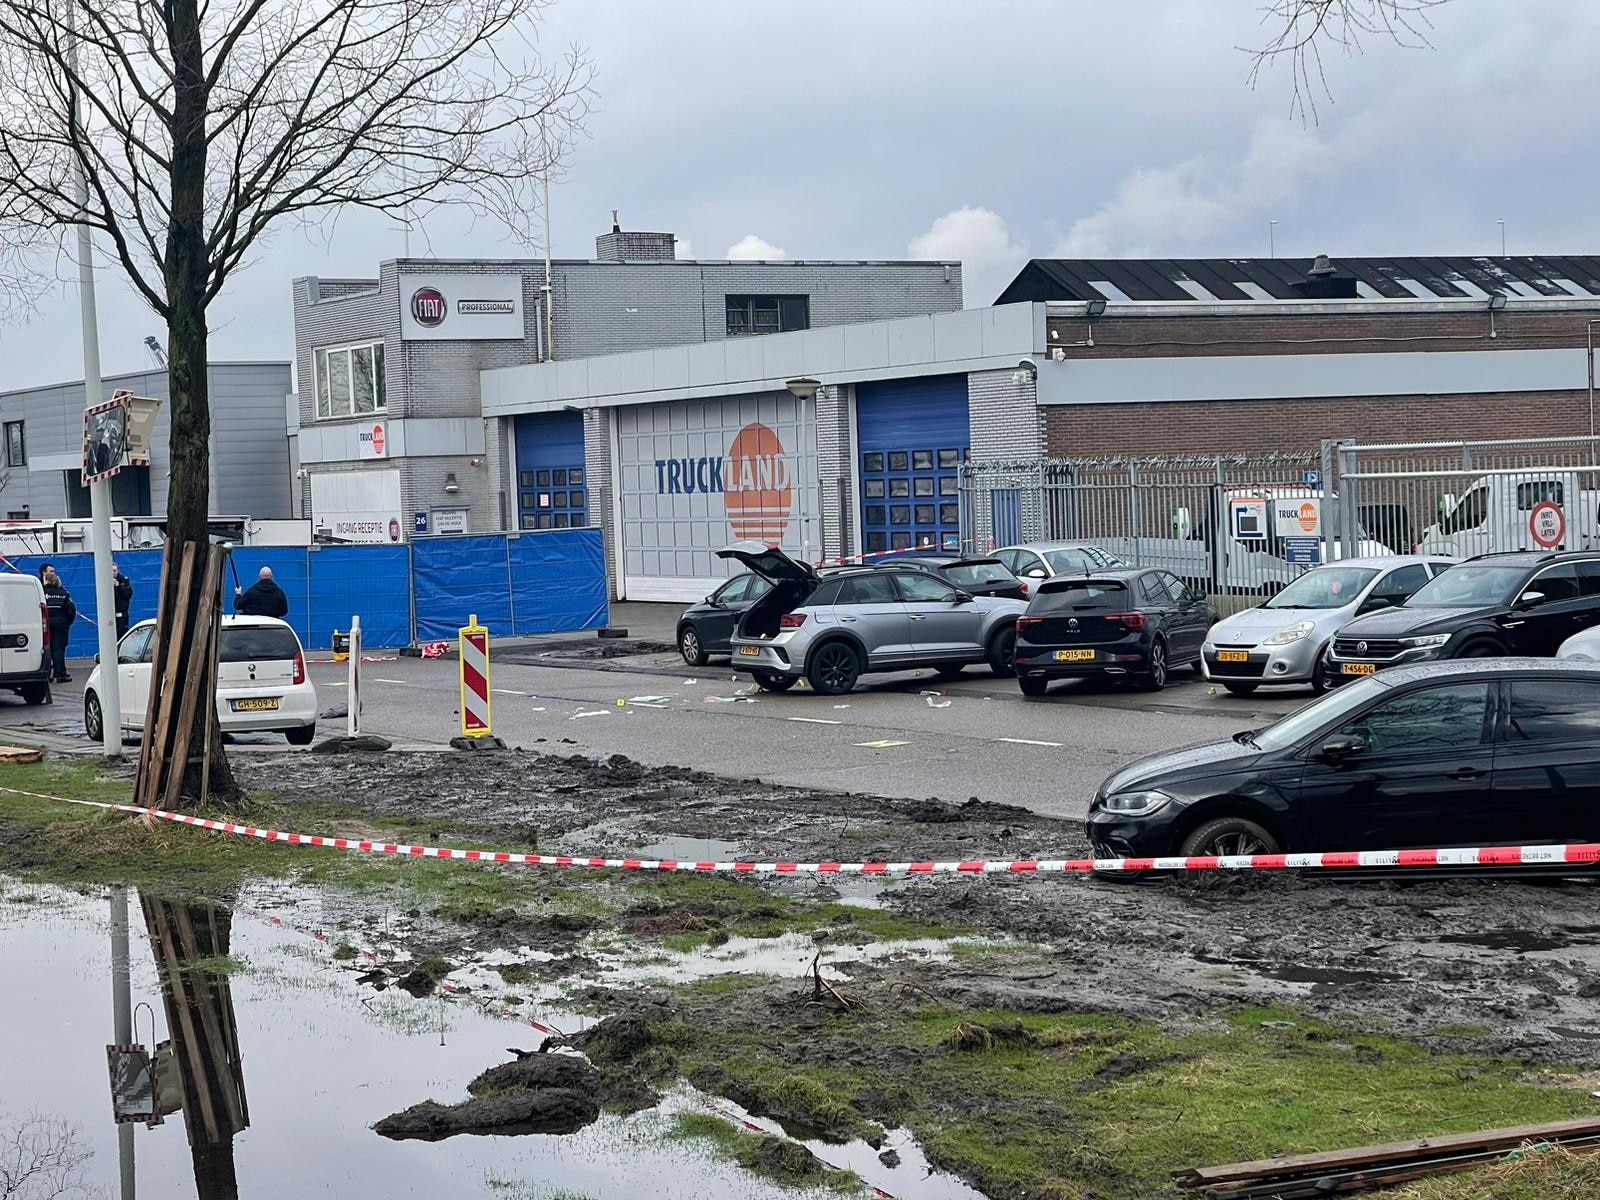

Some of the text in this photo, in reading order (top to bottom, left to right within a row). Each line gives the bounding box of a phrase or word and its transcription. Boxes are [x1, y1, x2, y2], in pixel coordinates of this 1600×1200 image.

[417, 298, 441, 318] FIAT
[461, 303, 511, 312] PROFESSIONAL
[655, 453, 791, 494] TRUCKLAND
[416, 516, 426, 525] 26
[336, 521, 384, 534] INGANG RECEPTIE
[1058, 650, 1092, 658] P-015-NN
[1344, 664, 1374, 674] T-456-DG
[237, 699, 276, 709] GH-509-Z
